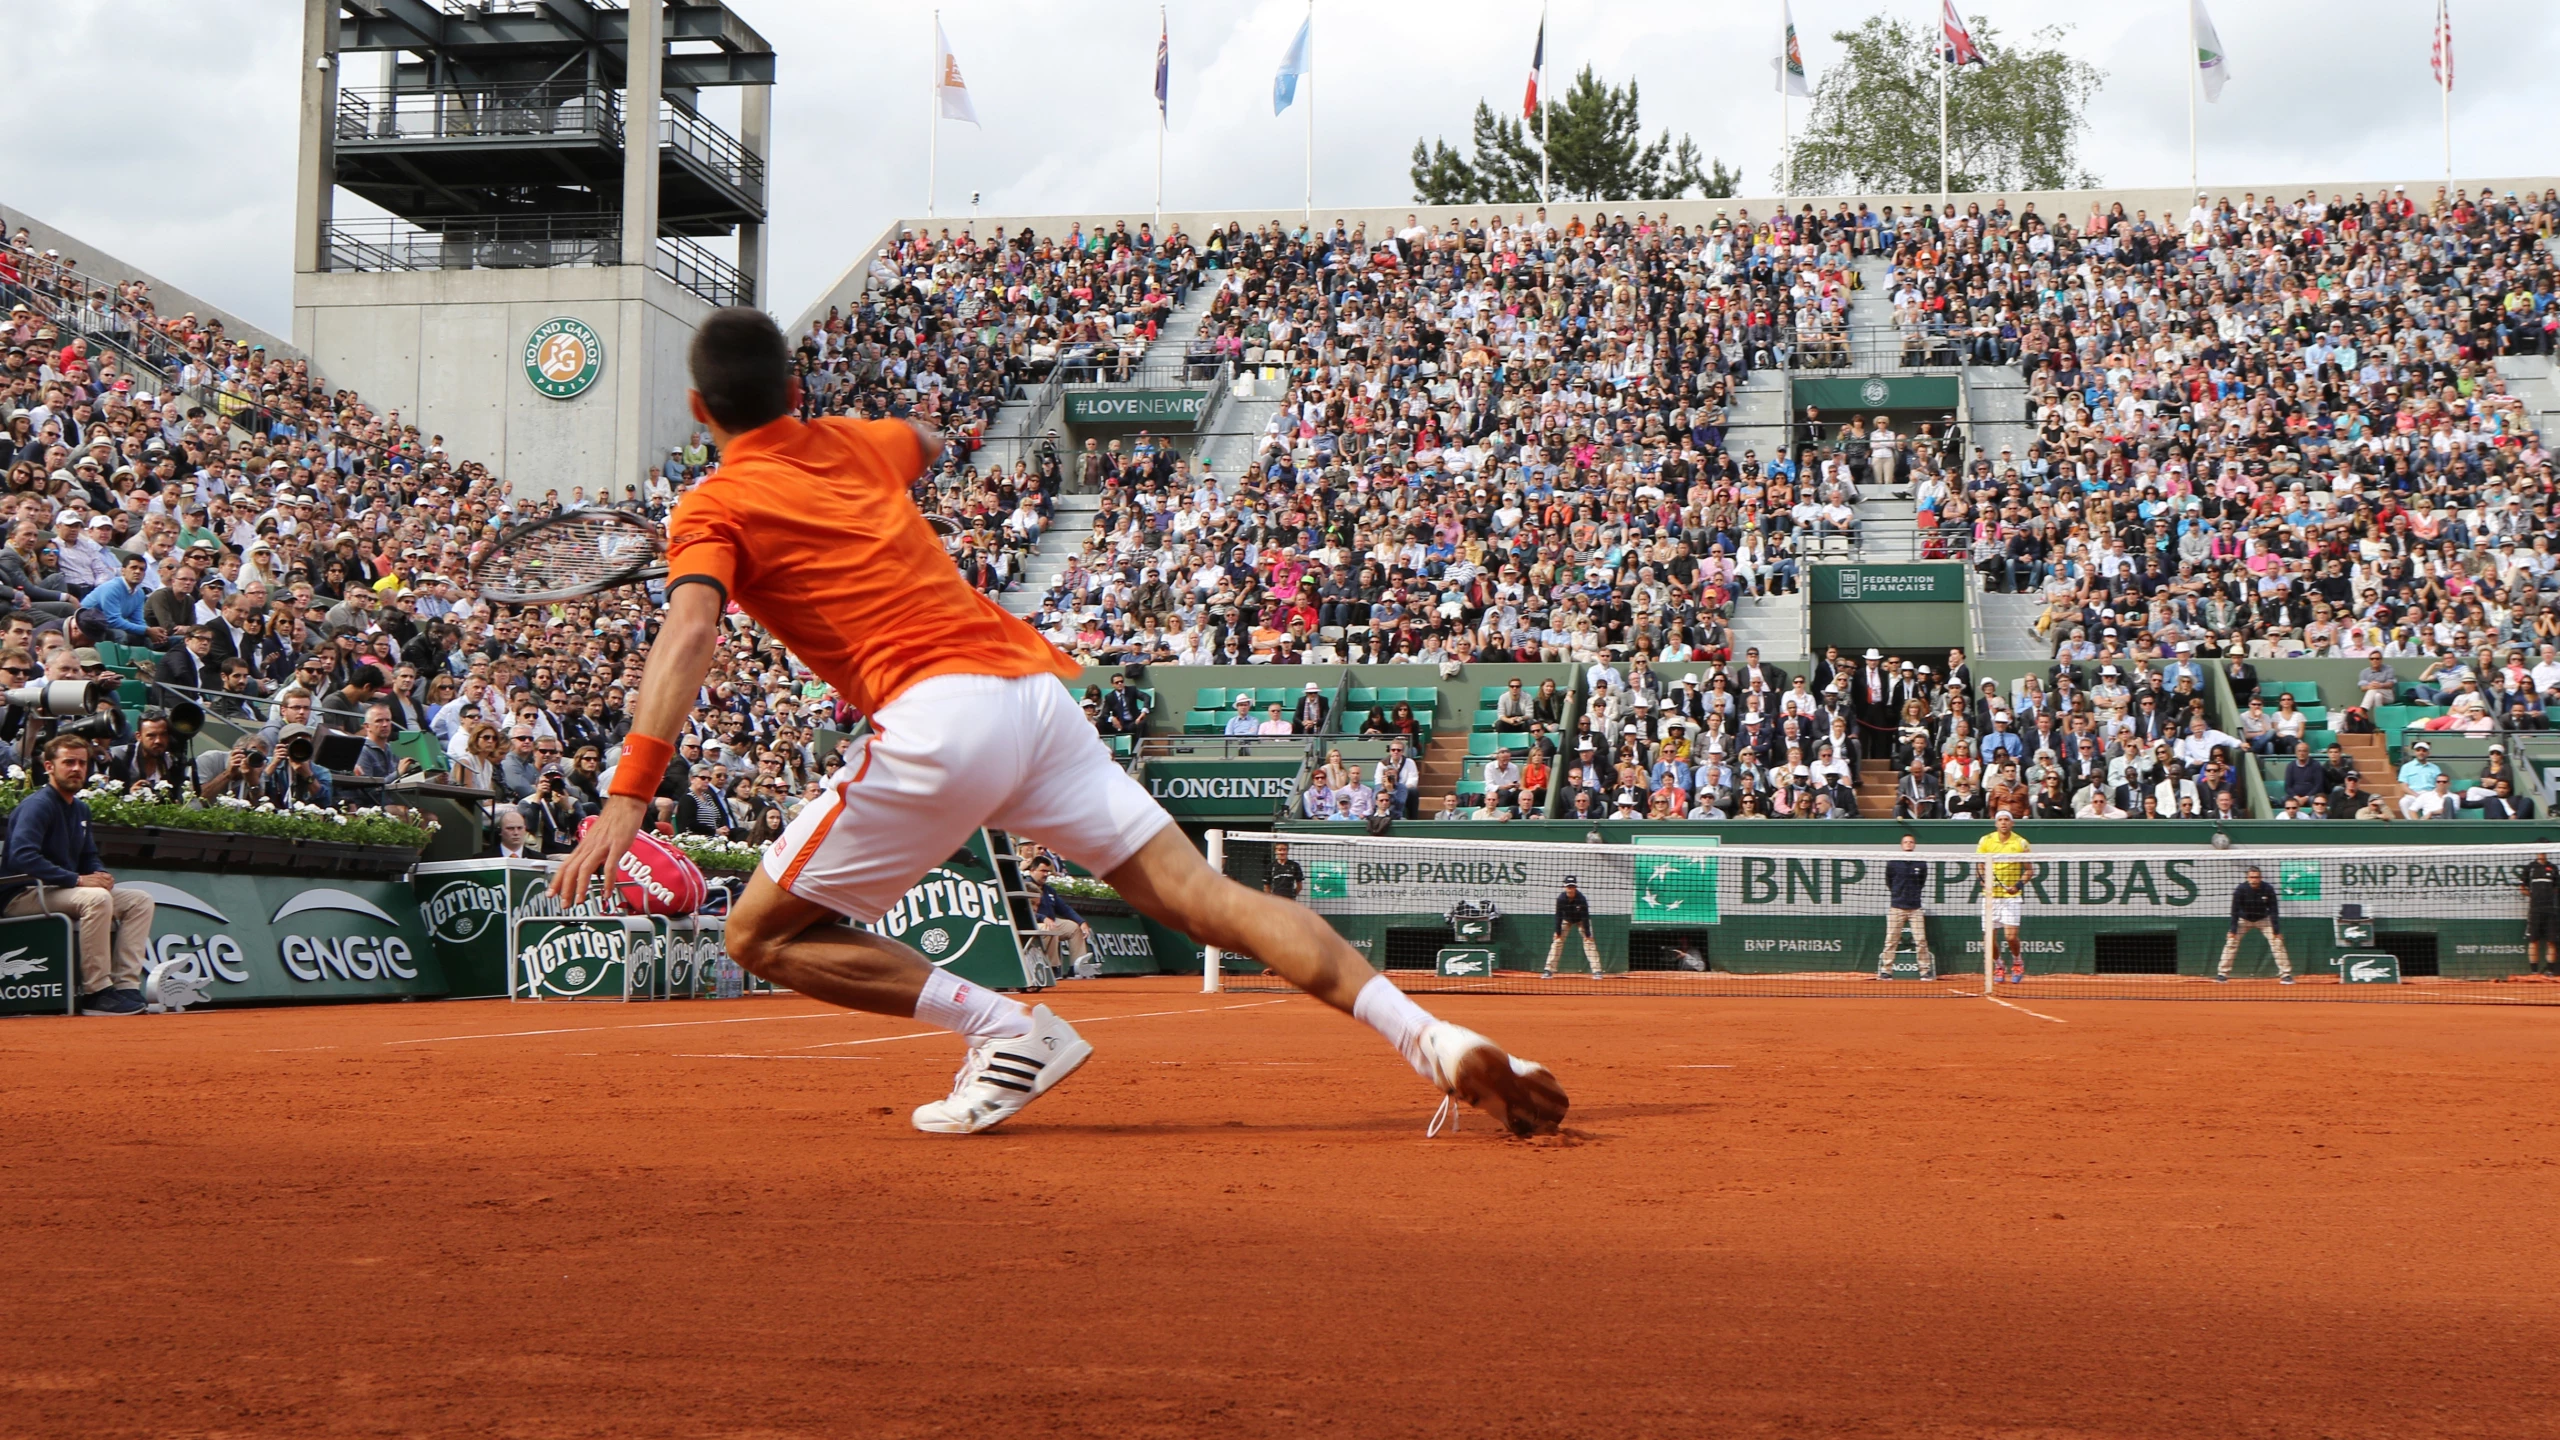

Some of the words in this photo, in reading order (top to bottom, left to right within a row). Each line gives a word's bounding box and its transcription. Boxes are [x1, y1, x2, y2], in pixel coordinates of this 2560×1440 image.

[526, 322, 561, 367] ROLAND
[565, 322, 598, 366] GARROS
[537, 376, 586, 393] PARIS
[1842, 573, 1857, 582] TEN
[1862, 583, 1935, 592] FRANÇAISE
[1150, 777, 1296, 798] LONGINES
[1357, 862, 1409, 885] BNP
[1417, 861, 1528, 885] PARIBAS
[1742, 856, 1867, 905] BNP
[2342, 864, 2398, 887] BNP
[1372, 888, 1407, 900] banque
[1436, 888, 1470, 897] monde
[1492, 887, 1528, 899] change
[1099, 932, 1153, 956] PEUGEOT
[1745, 939, 1776, 951] BNP
[1779, 939, 1842, 952] PARIBAS
